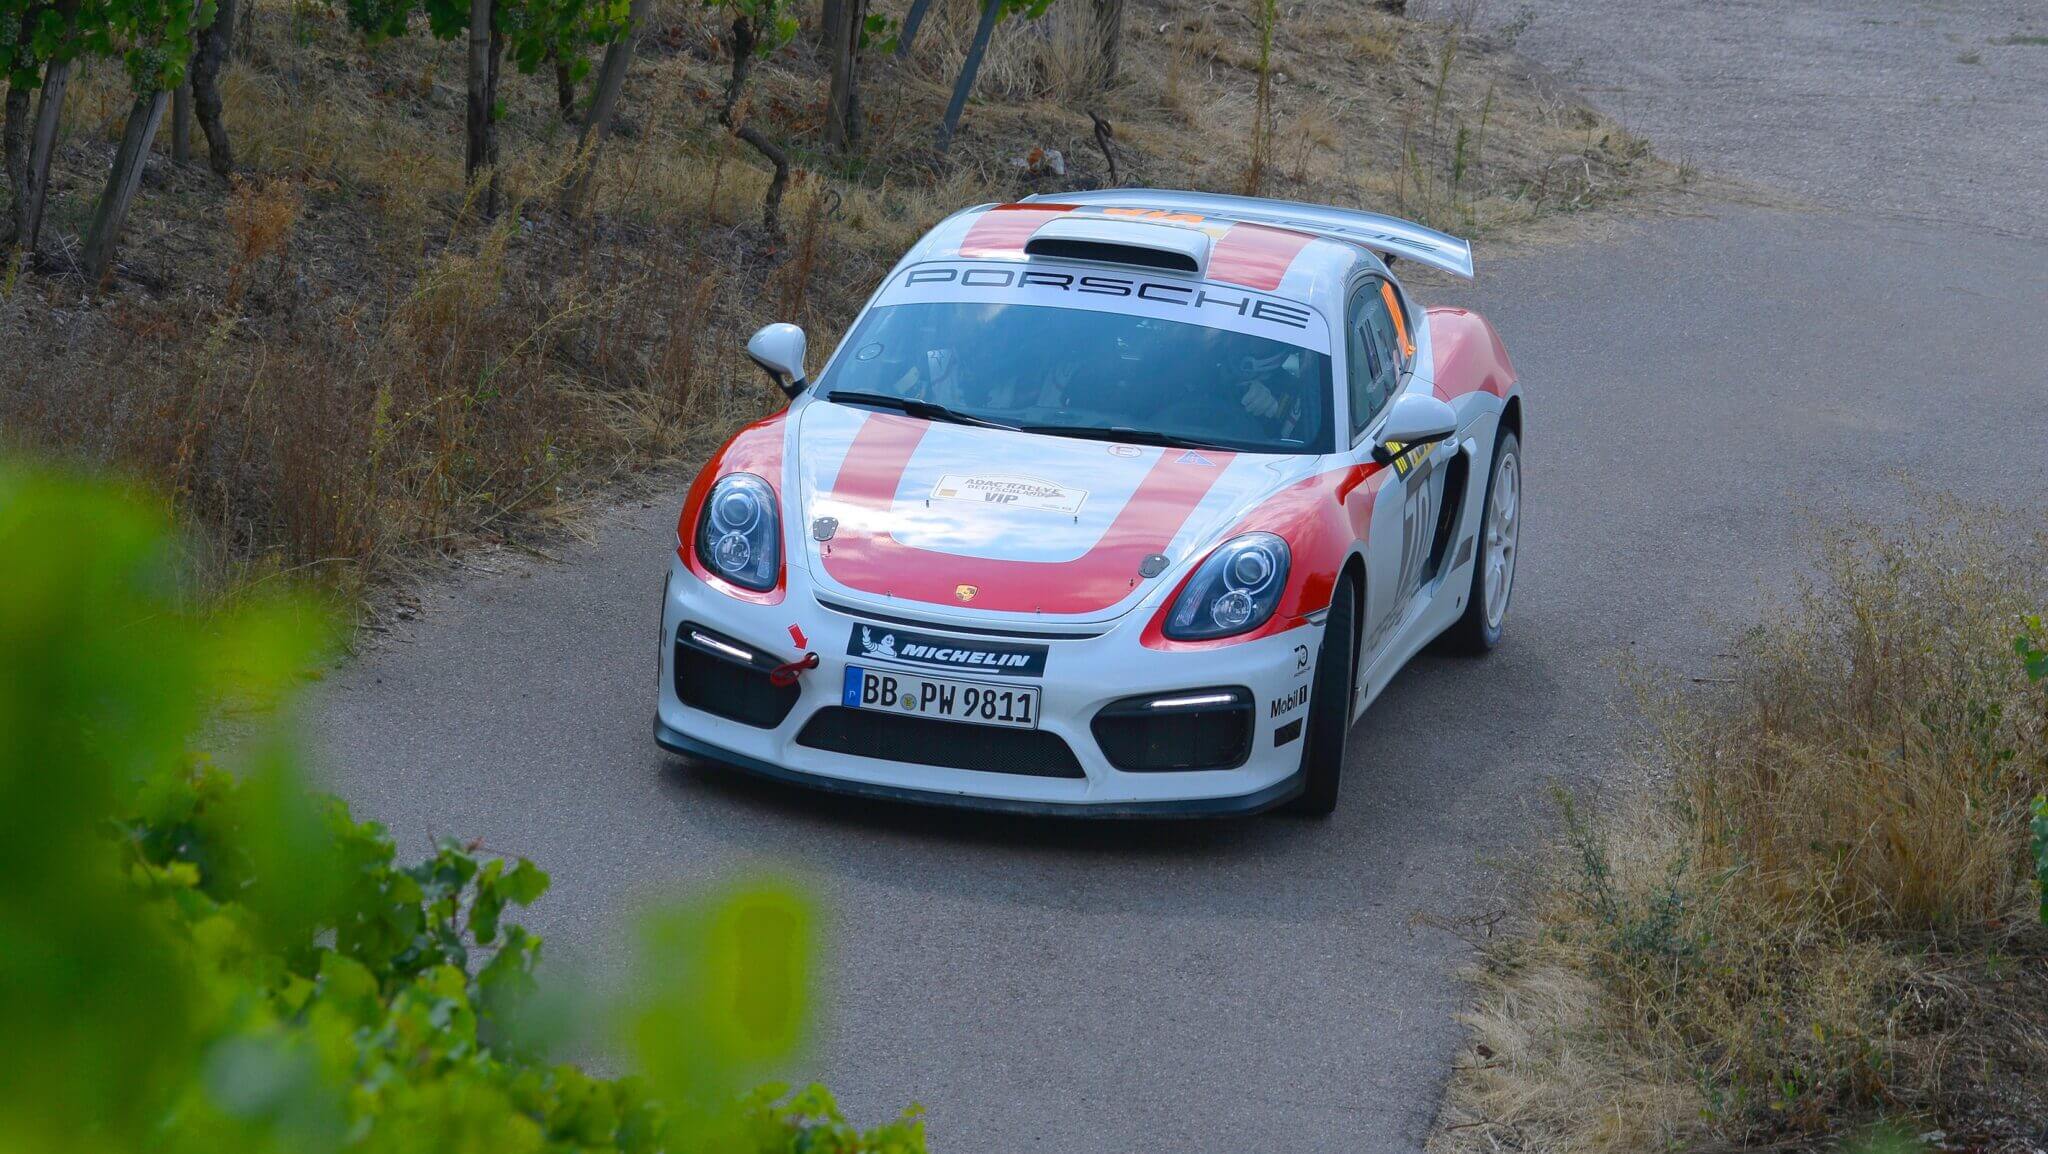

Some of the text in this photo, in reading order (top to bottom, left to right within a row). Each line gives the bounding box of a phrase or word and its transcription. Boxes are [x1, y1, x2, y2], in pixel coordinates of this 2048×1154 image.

[904, 268, 1312, 329] PORSCHE
[965, 479, 1064, 495] ADAC RALLYE
[985, 492, 1018, 504] VIP
[901, 644, 1030, 667] MICHELIN
[863, 674, 1032, 723] BB PW 9811
[1271, 689, 1299, 718] Mobil
